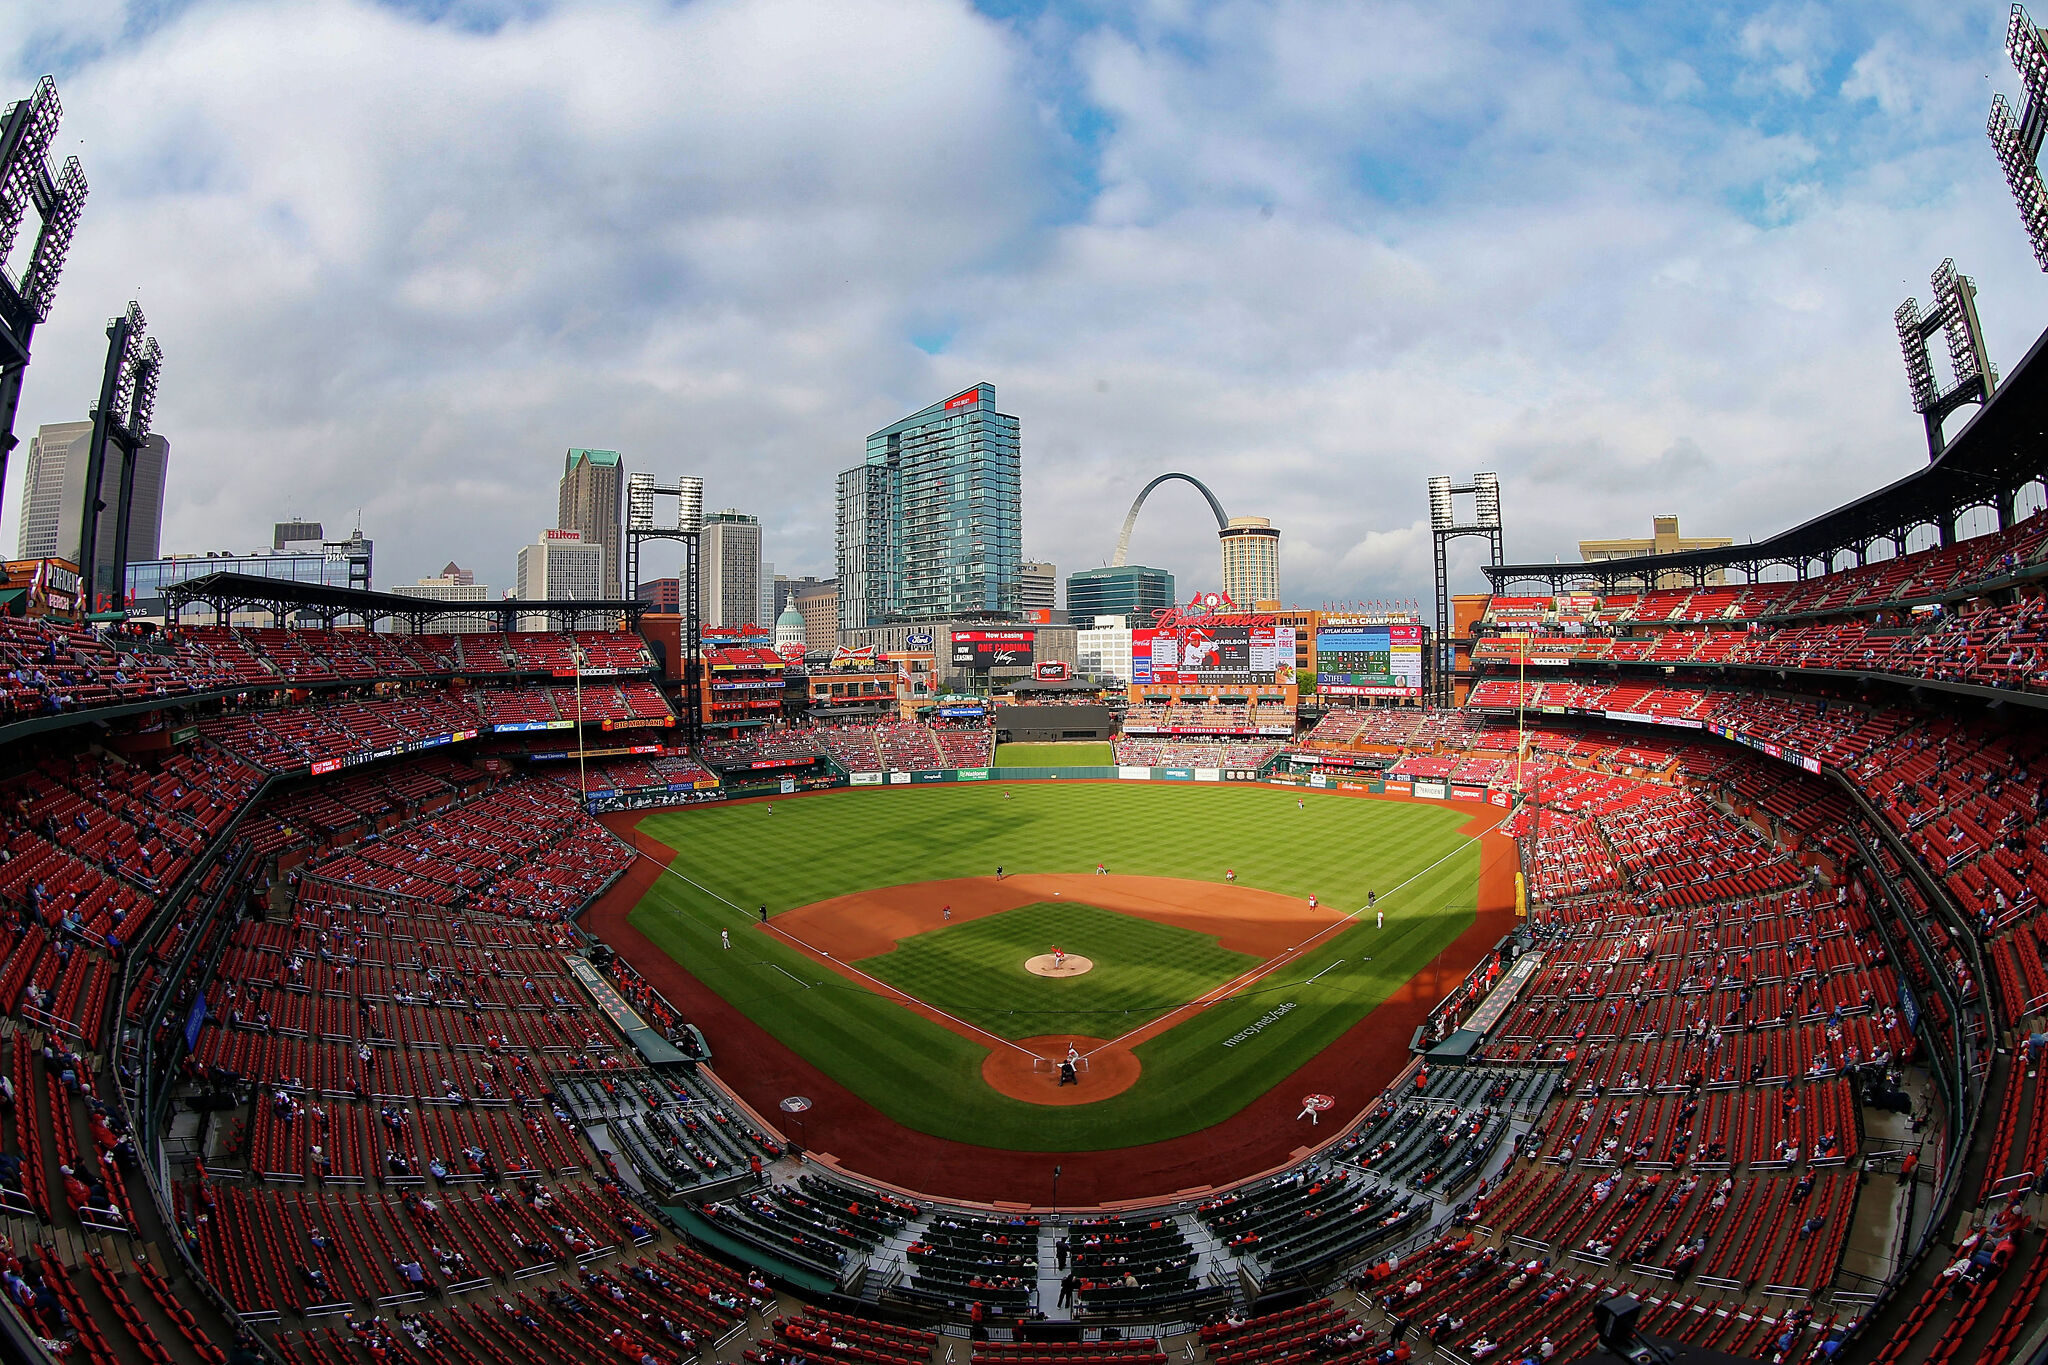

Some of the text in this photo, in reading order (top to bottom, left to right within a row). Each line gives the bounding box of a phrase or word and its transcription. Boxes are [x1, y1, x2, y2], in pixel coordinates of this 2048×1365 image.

[546, 530, 580, 540] Hilton
[325, 553, 350, 564] pwc
[1151, 608, 1276, 628] Budweiser
[912, 634, 929, 644] Ford
[978, 644, 1031, 652] ONE CARDINAL
[1324, 674, 1343, 682] STIFEL
[1365, 687, 1406, 695] CROUPPEN
[1222, 1002, 1297, 1048] mercy.net/safe
